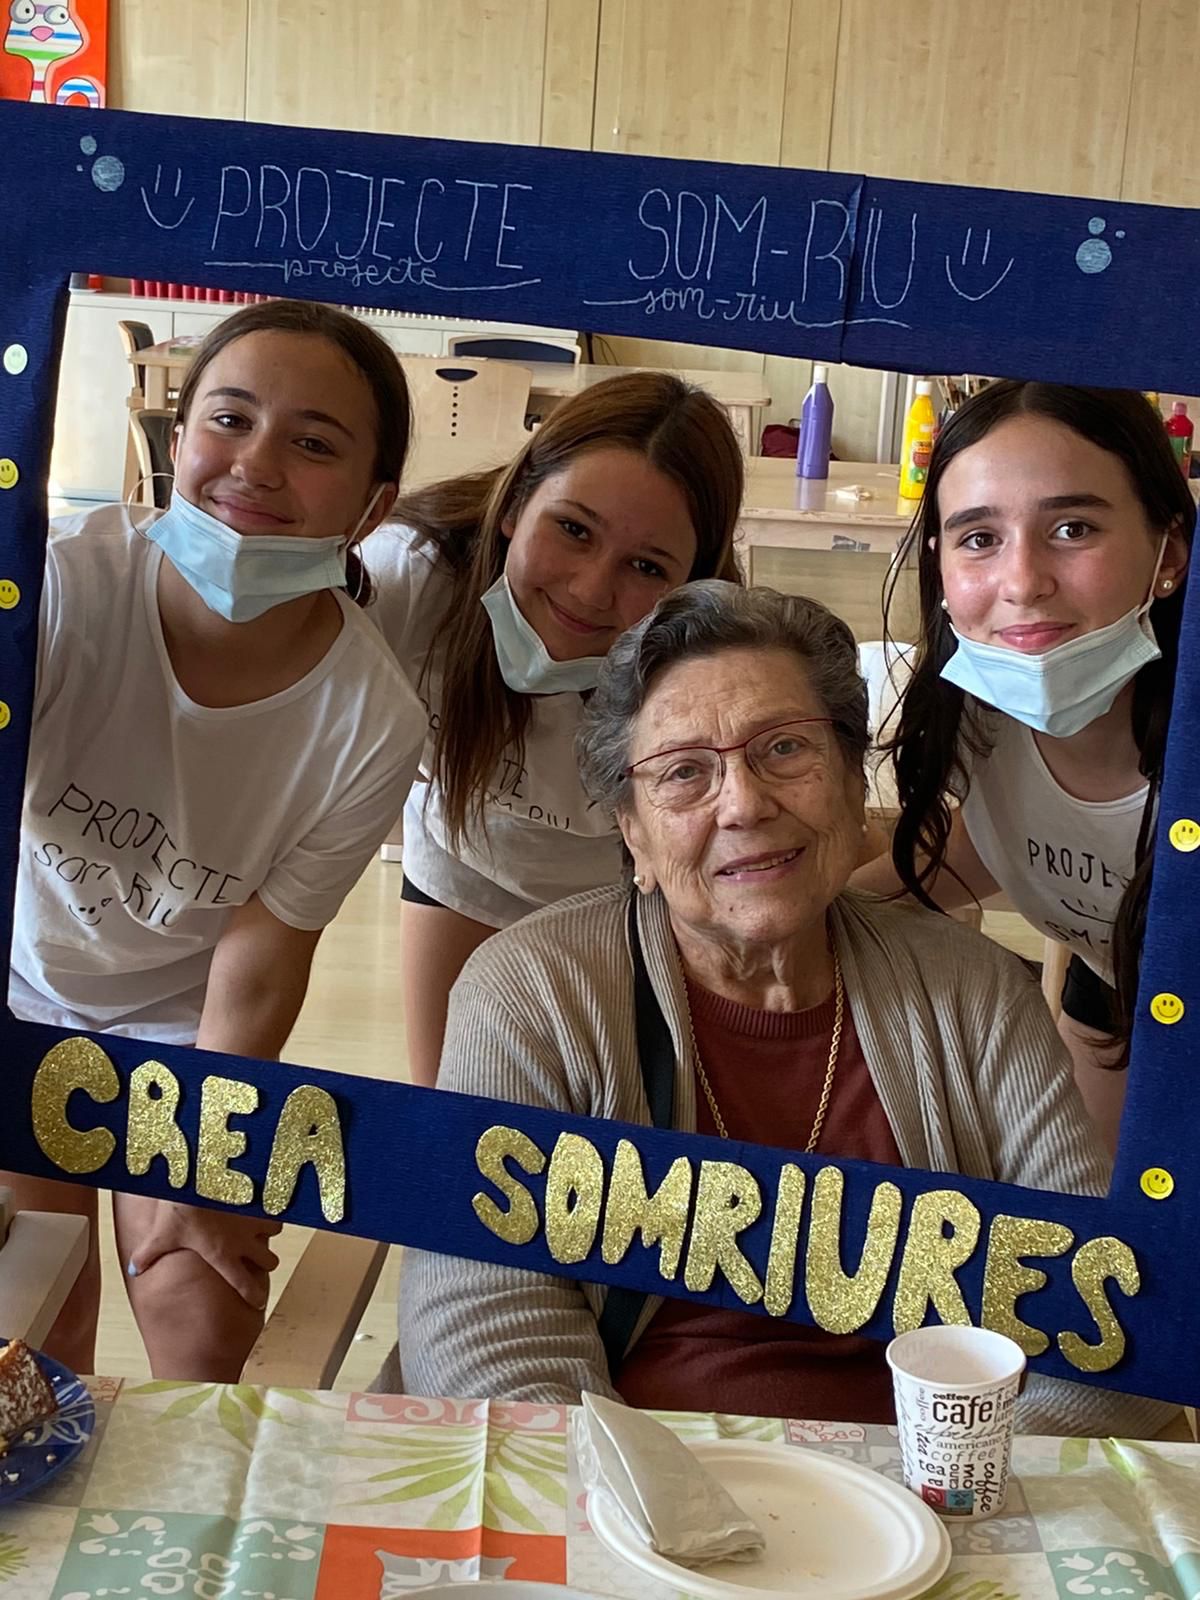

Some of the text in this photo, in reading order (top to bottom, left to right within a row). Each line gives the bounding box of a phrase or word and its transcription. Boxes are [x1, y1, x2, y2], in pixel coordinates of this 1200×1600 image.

[211, 164, 533, 269] PROJECTE
[281, 256, 799, 321] projecte som-riu
[47, 783, 243, 904] PROJECTE
[31, 1036, 1140, 1373] CREA SOMRIURES
[932, 1393, 971, 1401] coffee
[932, 1395, 993, 1430] cafe
[930, 1448, 996, 1463] coffee
[936, 1435, 1003, 1450] americano
[919, 1458, 946, 1477] tea
[975, 1462, 999, 1513] coffee
